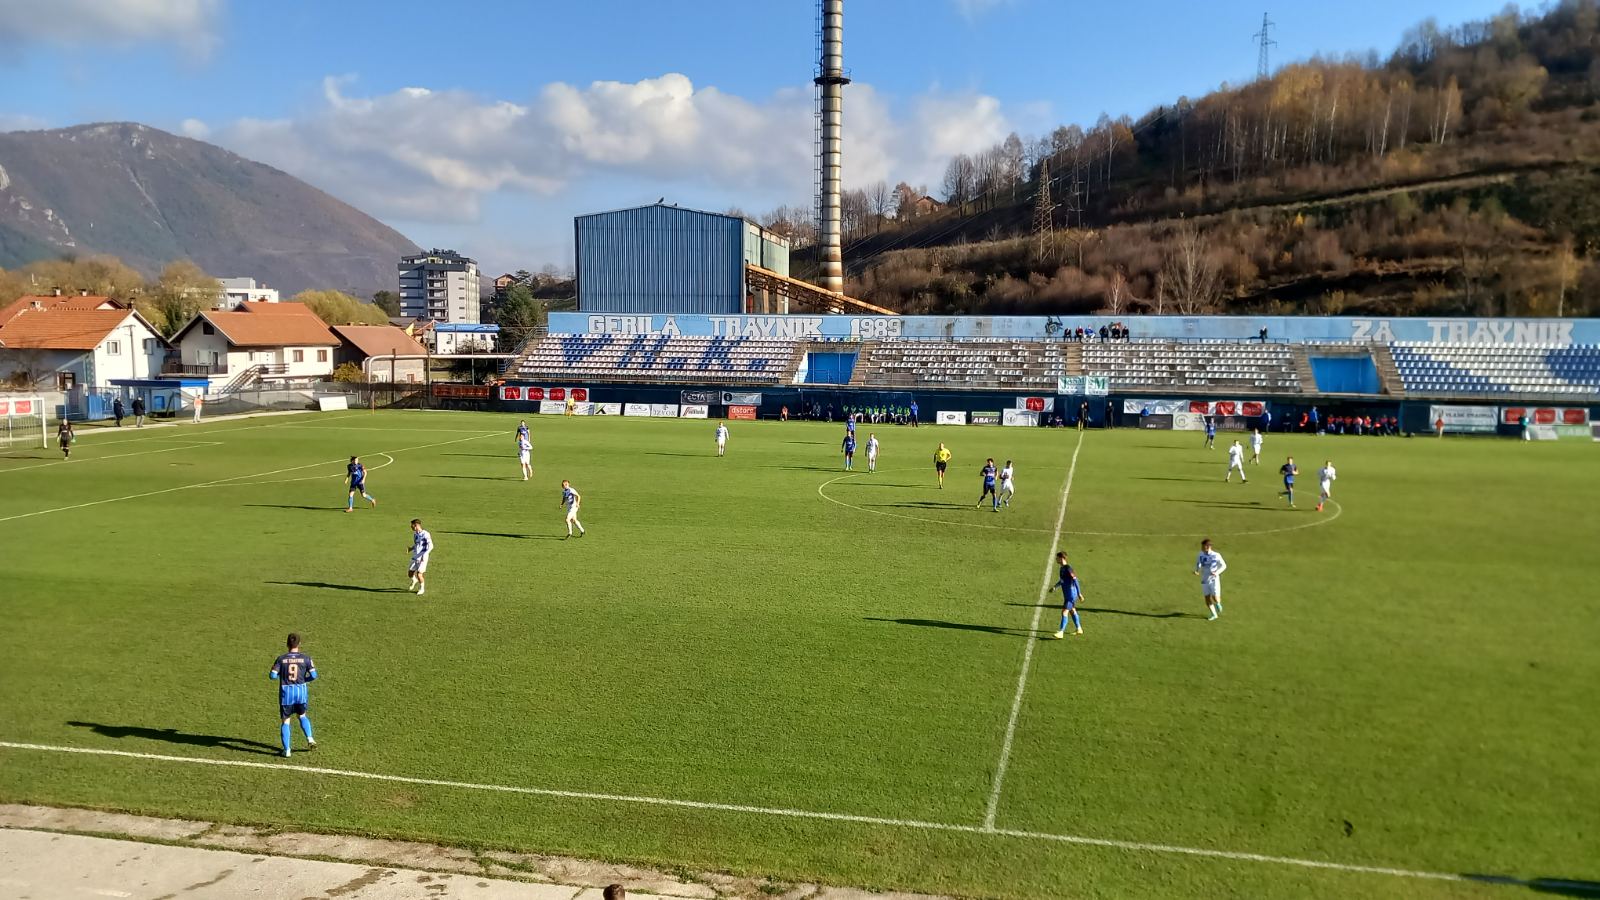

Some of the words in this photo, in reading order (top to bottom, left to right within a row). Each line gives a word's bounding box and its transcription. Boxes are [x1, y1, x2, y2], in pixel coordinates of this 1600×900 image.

[588, 315, 682, 335] GERILA
[850, 318, 902, 338] 1989
[1351, 320, 1395, 342] ZA
[288, 664, 298, 681] 9
